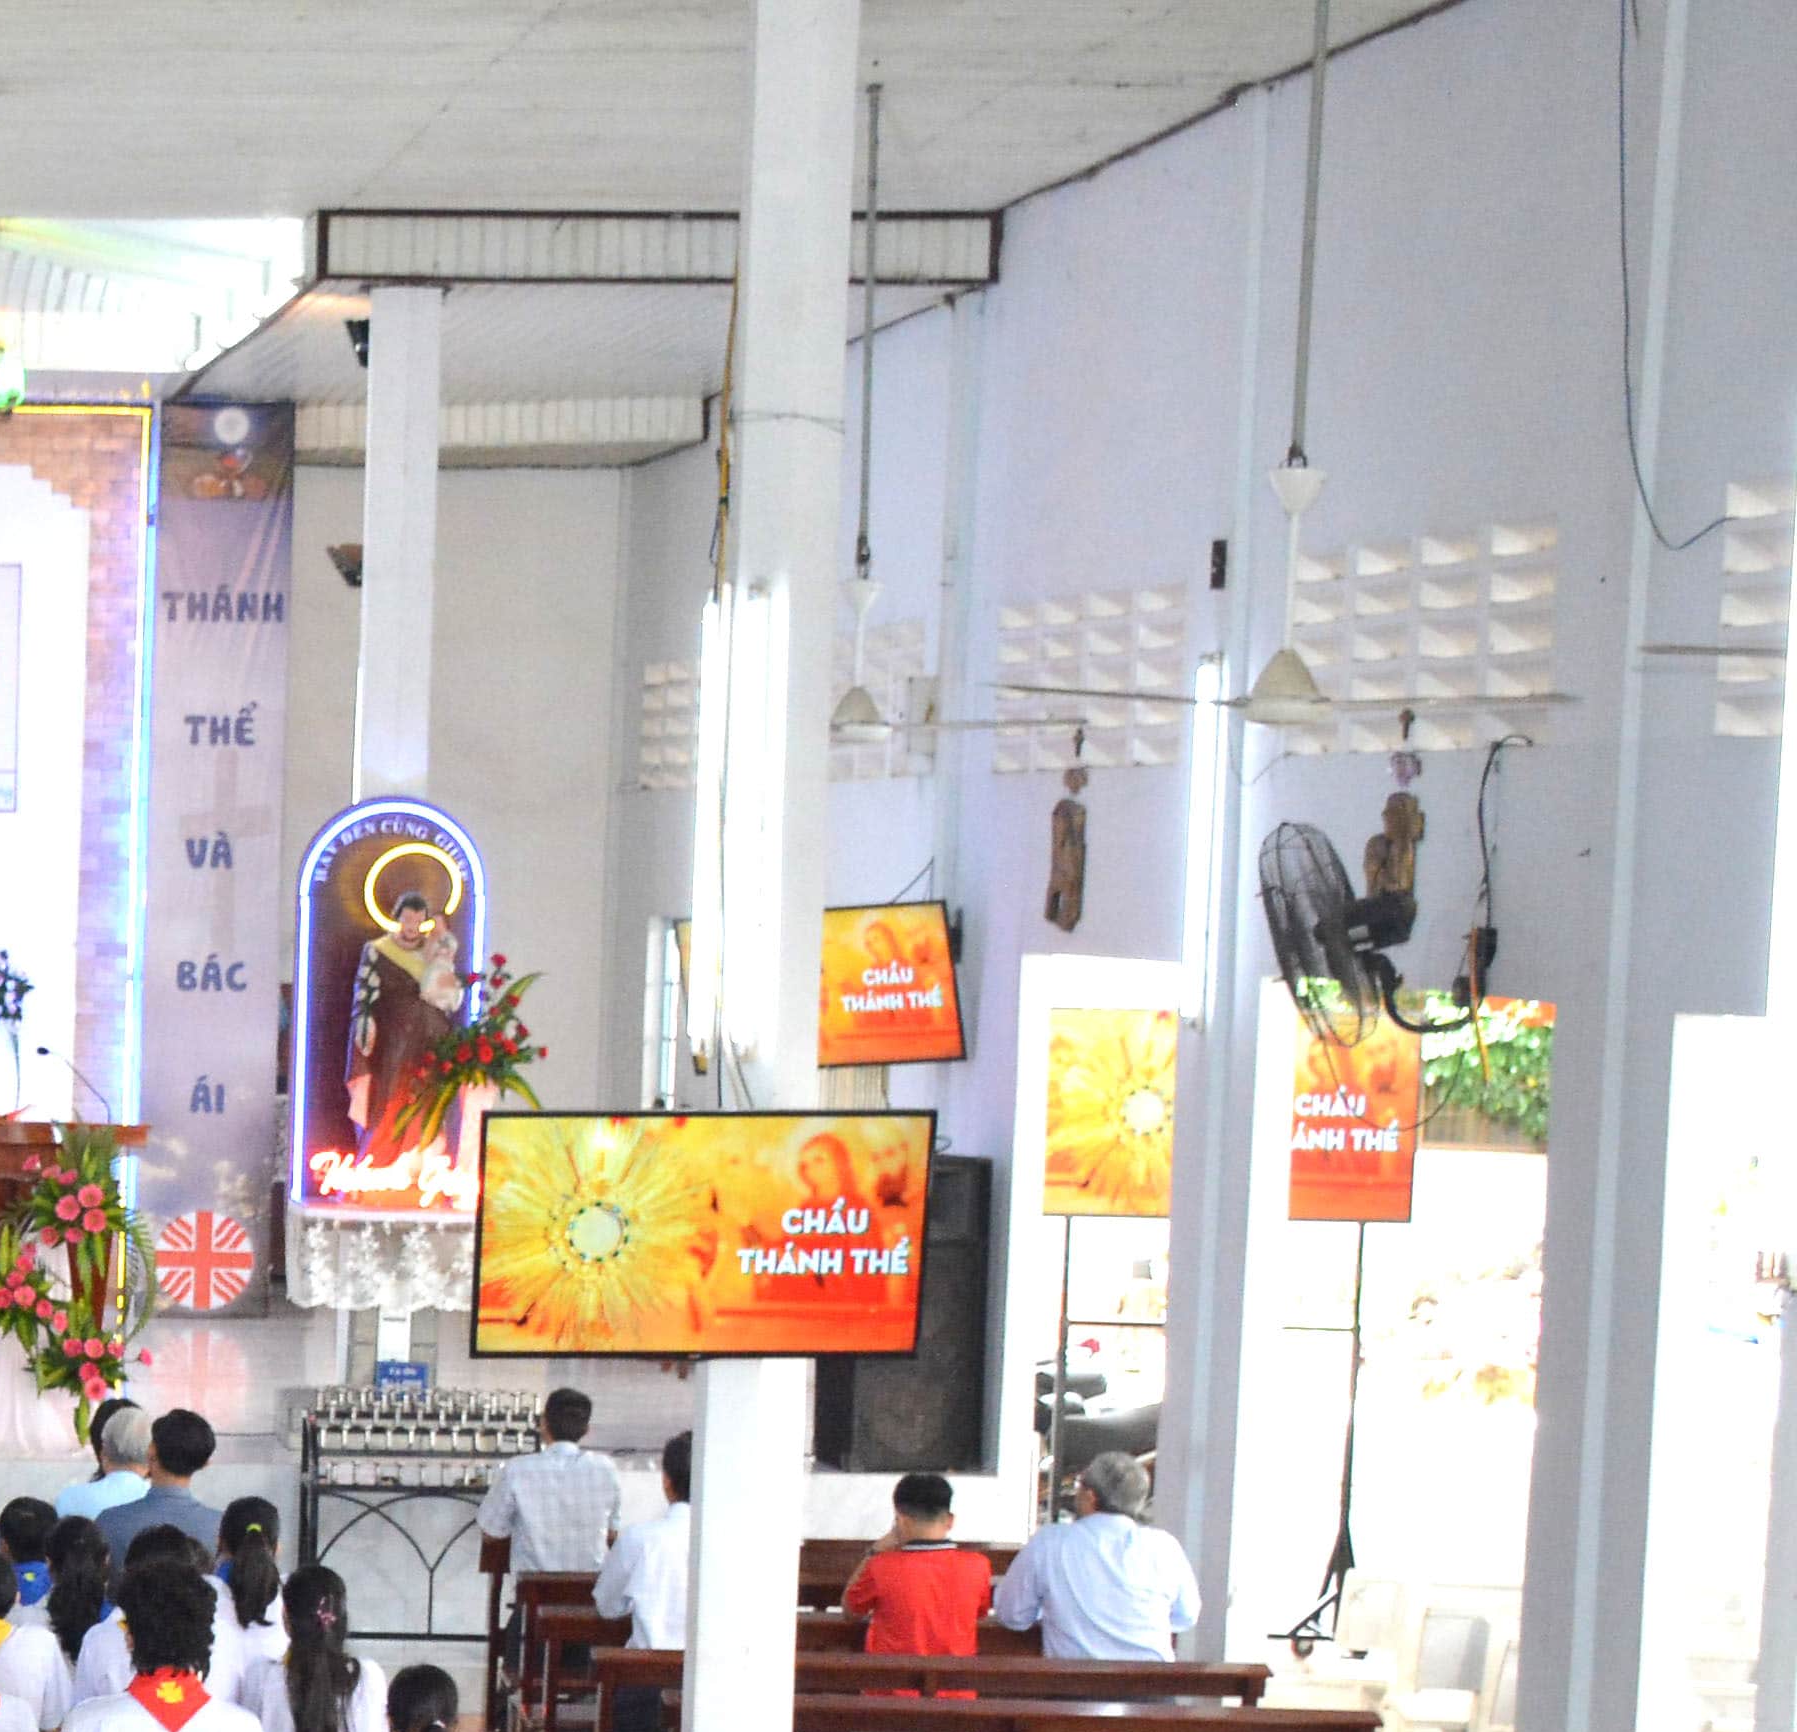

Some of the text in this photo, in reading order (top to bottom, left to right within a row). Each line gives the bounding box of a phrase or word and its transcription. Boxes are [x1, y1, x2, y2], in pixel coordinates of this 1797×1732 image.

[162, 584, 285, 622] THÁNH
[184, 701, 257, 746] THỂ
[185, 832, 233, 869] VÀ
[176, 954, 247, 992] BÁC
[841, 989, 904, 1011] THÁNH
[190, 1074, 225, 1113] ÁI
[736, 1236, 909, 1274] THÁNH THỂ
